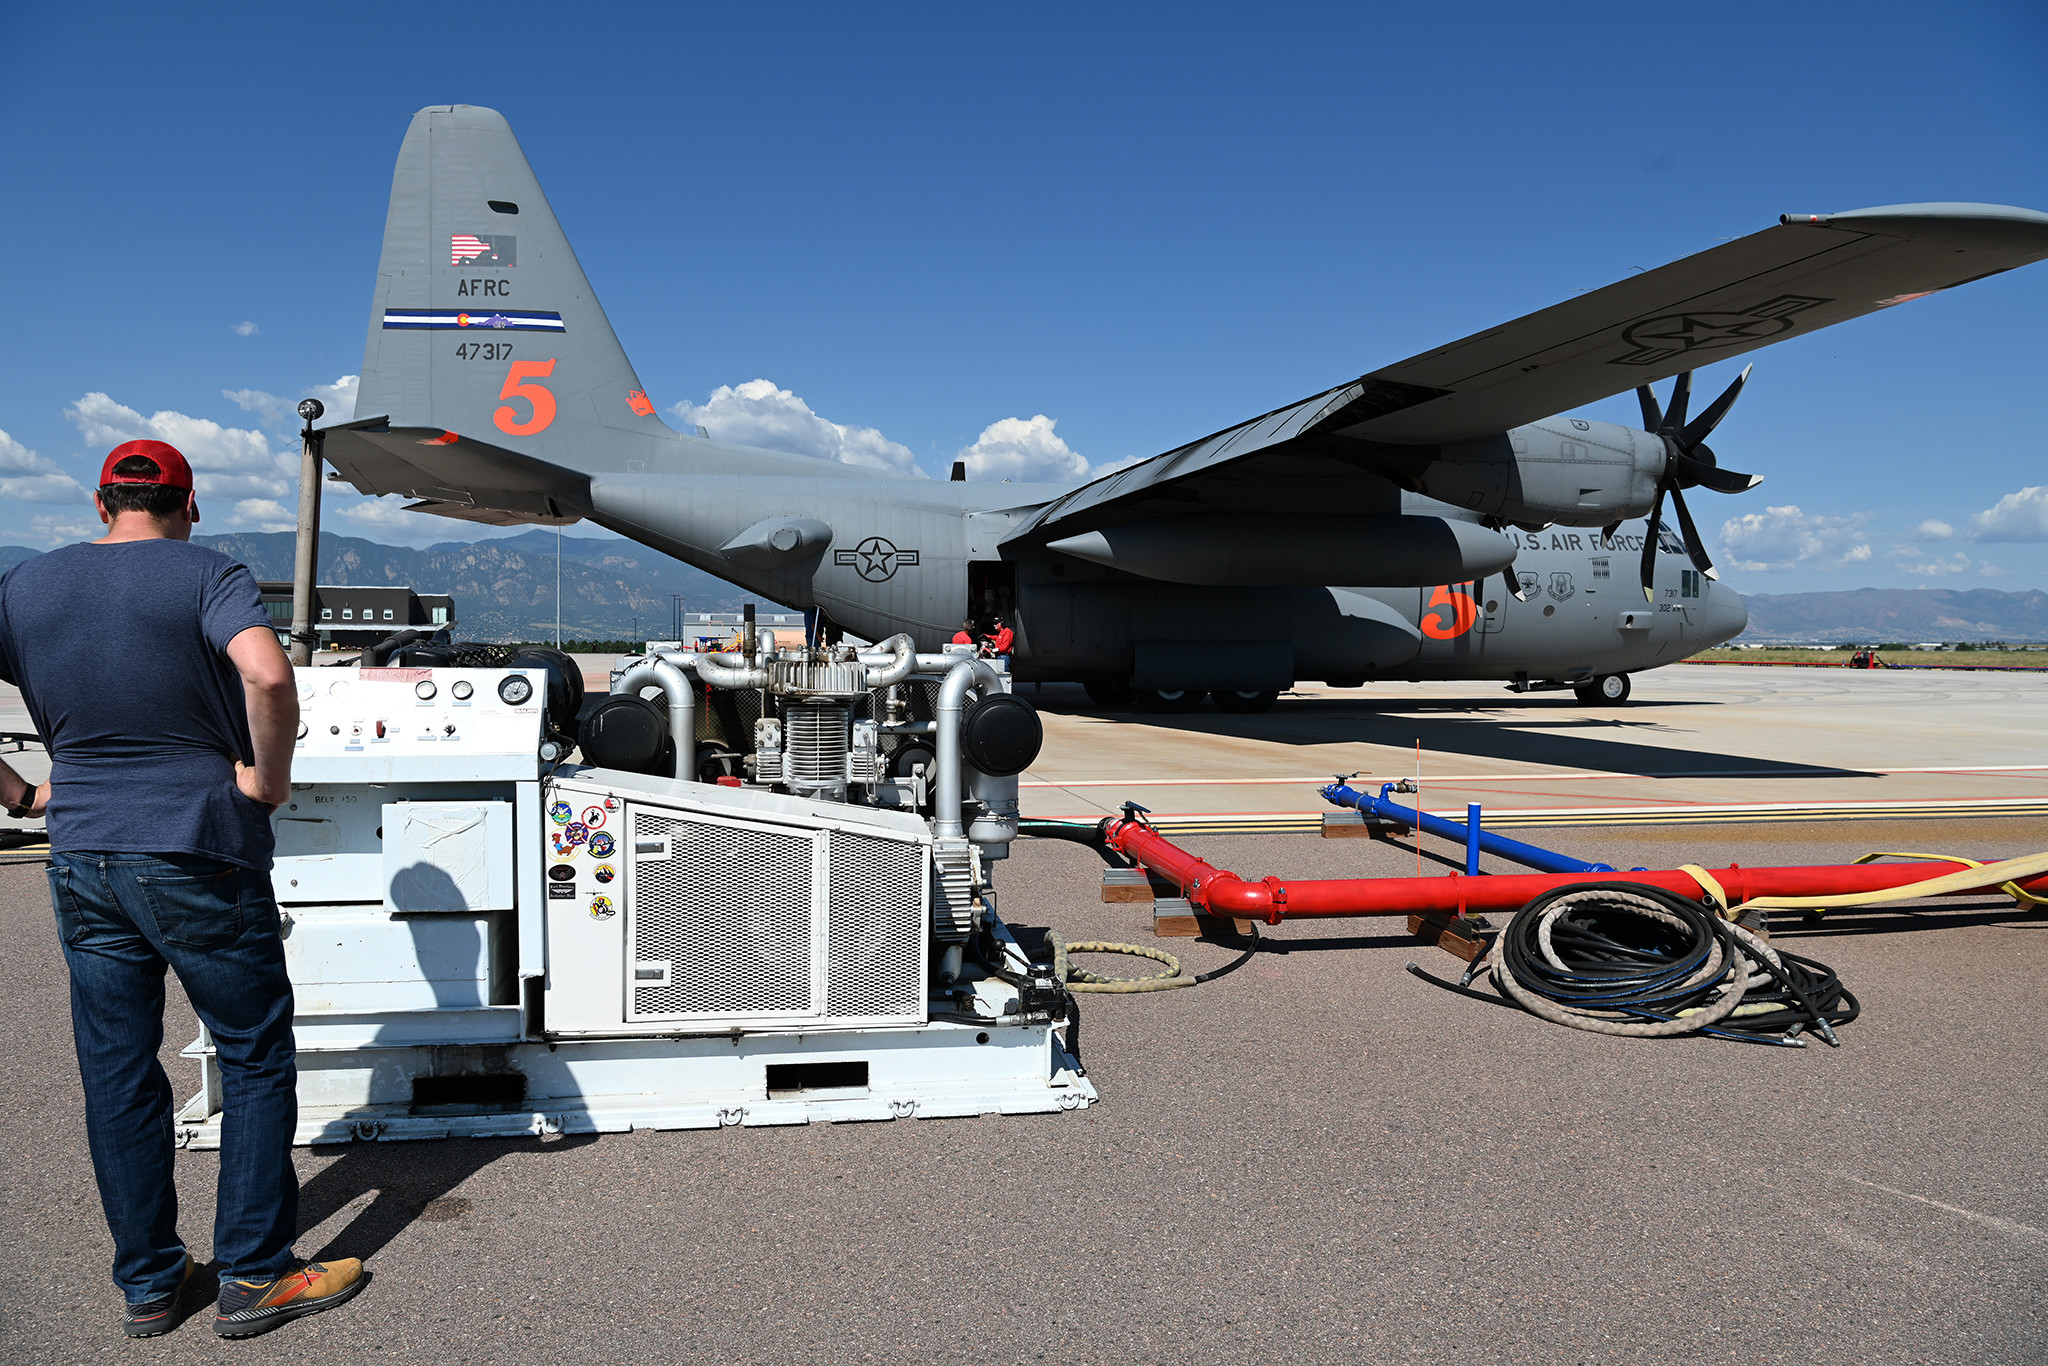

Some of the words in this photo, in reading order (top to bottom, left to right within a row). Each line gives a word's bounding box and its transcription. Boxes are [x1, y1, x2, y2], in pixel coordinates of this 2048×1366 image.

[457, 279, 510, 296] AFRC
[456, 343, 513, 360] 47317
[493, 357, 557, 436] 5
[1505, 533, 1547, 551] U.S.
[1551, 533, 1584, 551] AIR
[1421, 580, 1477, 640] 5
[1659, 604, 1671, 612] 302
[315, 796, 335, 804] BELT
